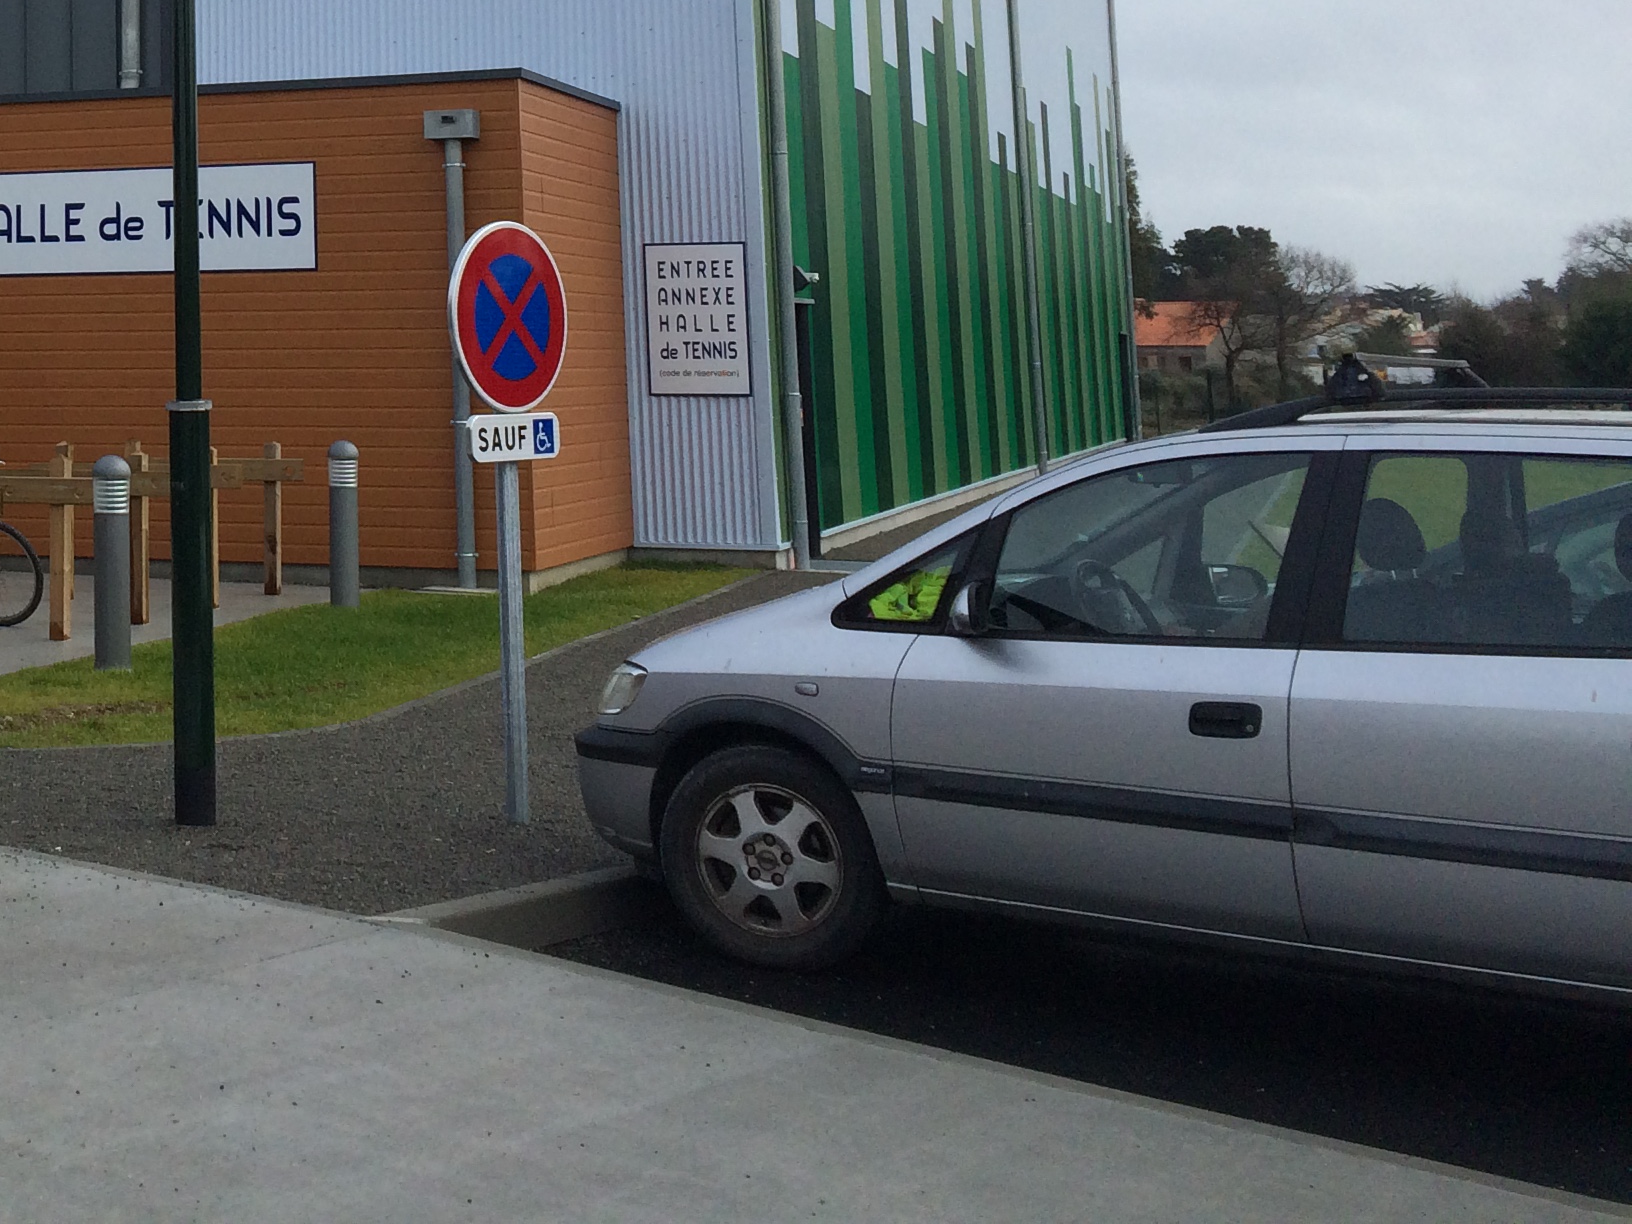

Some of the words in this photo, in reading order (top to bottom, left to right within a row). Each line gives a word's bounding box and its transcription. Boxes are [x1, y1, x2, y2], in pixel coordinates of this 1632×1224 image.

[98, 200, 145, 242] de
[156, 195, 303, 241] TNNIS
[656, 259, 735, 279] ENTREE
[657, 286, 736, 306] ANNEXE
[658, 313, 737, 333] HALLE
[659, 340, 679, 360] de
[682, 340, 738, 360] TENNIS
[478, 424, 528, 453] SAUF
